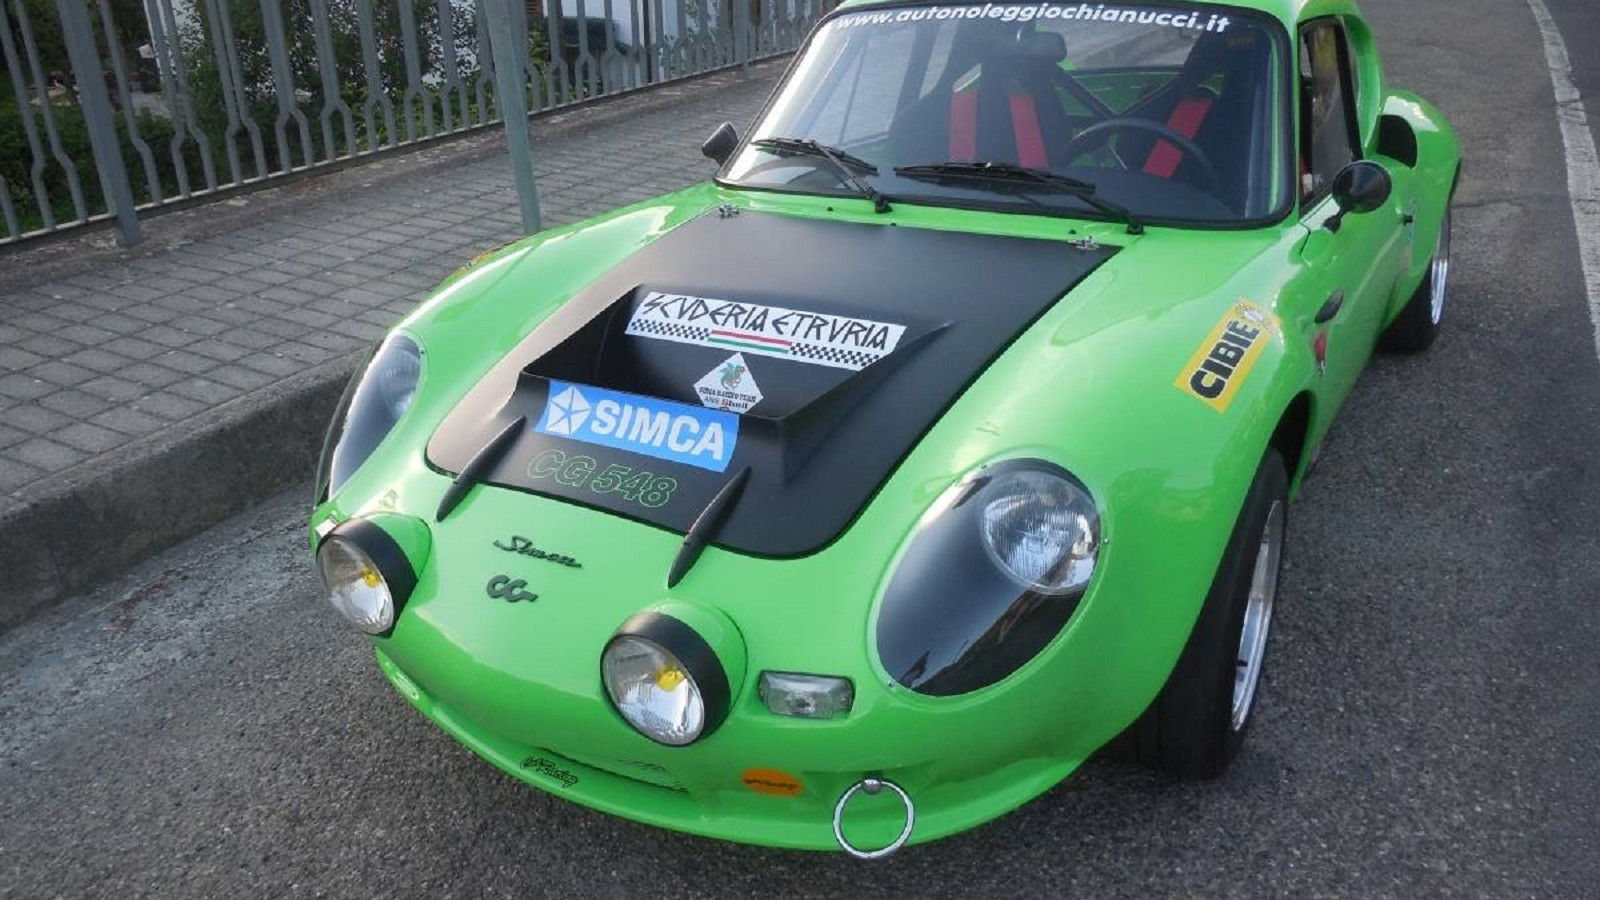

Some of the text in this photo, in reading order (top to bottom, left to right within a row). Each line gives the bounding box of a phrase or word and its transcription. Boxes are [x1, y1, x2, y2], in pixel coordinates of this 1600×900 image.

[837, 3, 1231, 33] www.autonoleggiochianucci.it
[590, 399, 725, 461] SIMCA
[527, 450, 678, 508] CG 548
